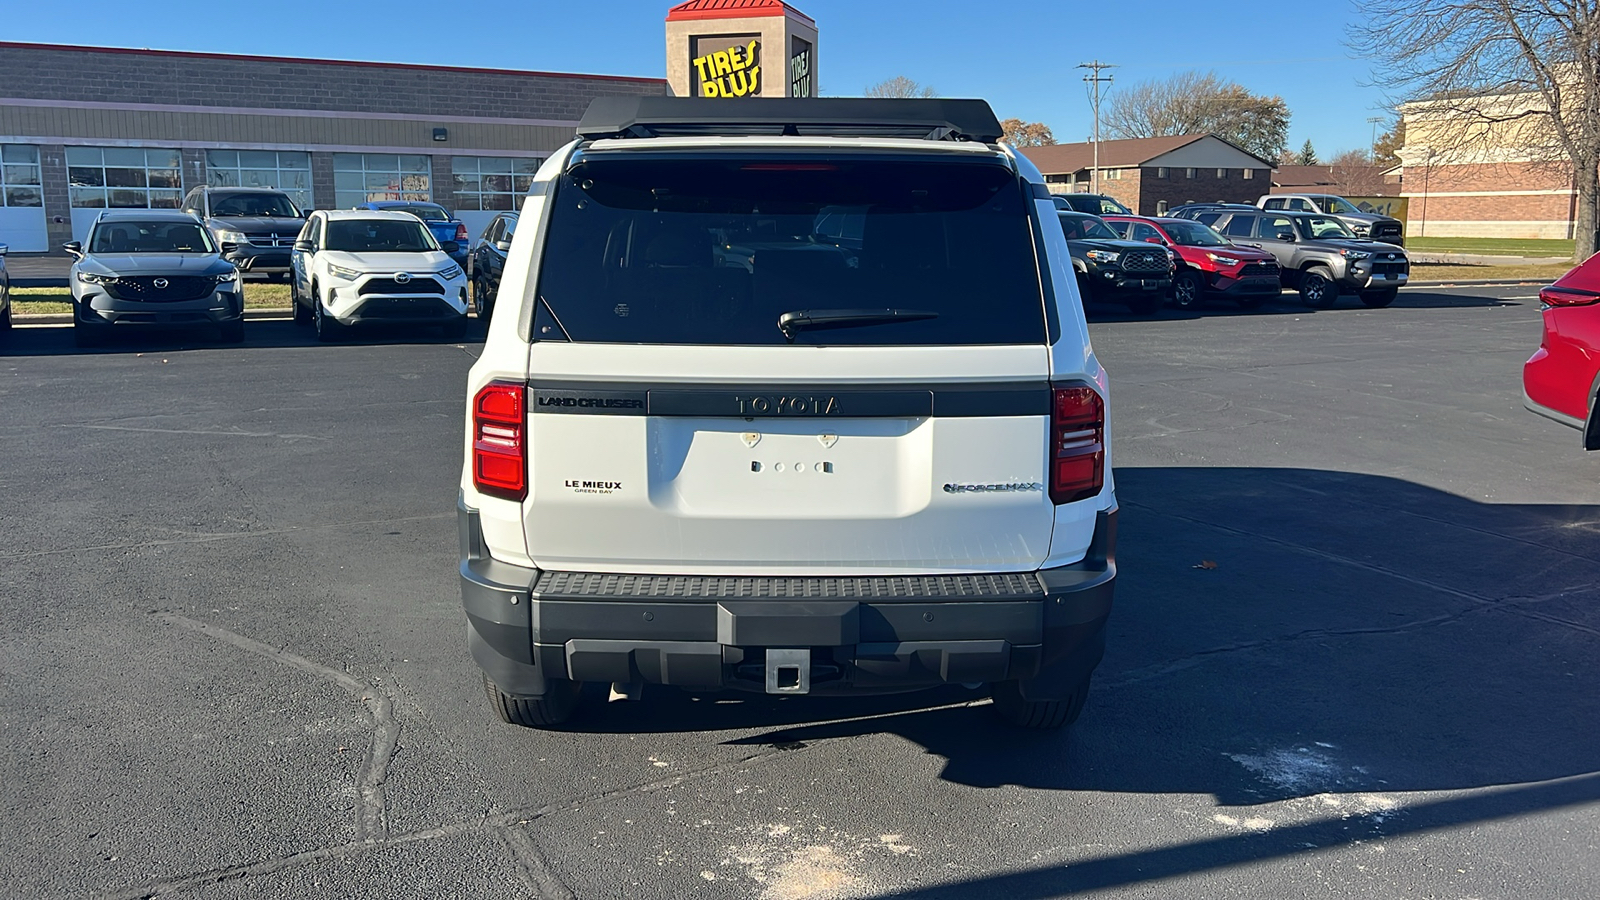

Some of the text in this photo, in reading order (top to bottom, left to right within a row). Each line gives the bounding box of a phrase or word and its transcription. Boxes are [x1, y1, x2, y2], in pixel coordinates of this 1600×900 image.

[693, 40, 758, 82] TIRES
[791, 51, 809, 83] TIRES
[702, 66, 760, 98] PLUS
[538, 397, 644, 409] LAND CRUISER
[735, 396, 844, 414] TOYOTA
[565, 480, 622, 489] LE MIEUX
